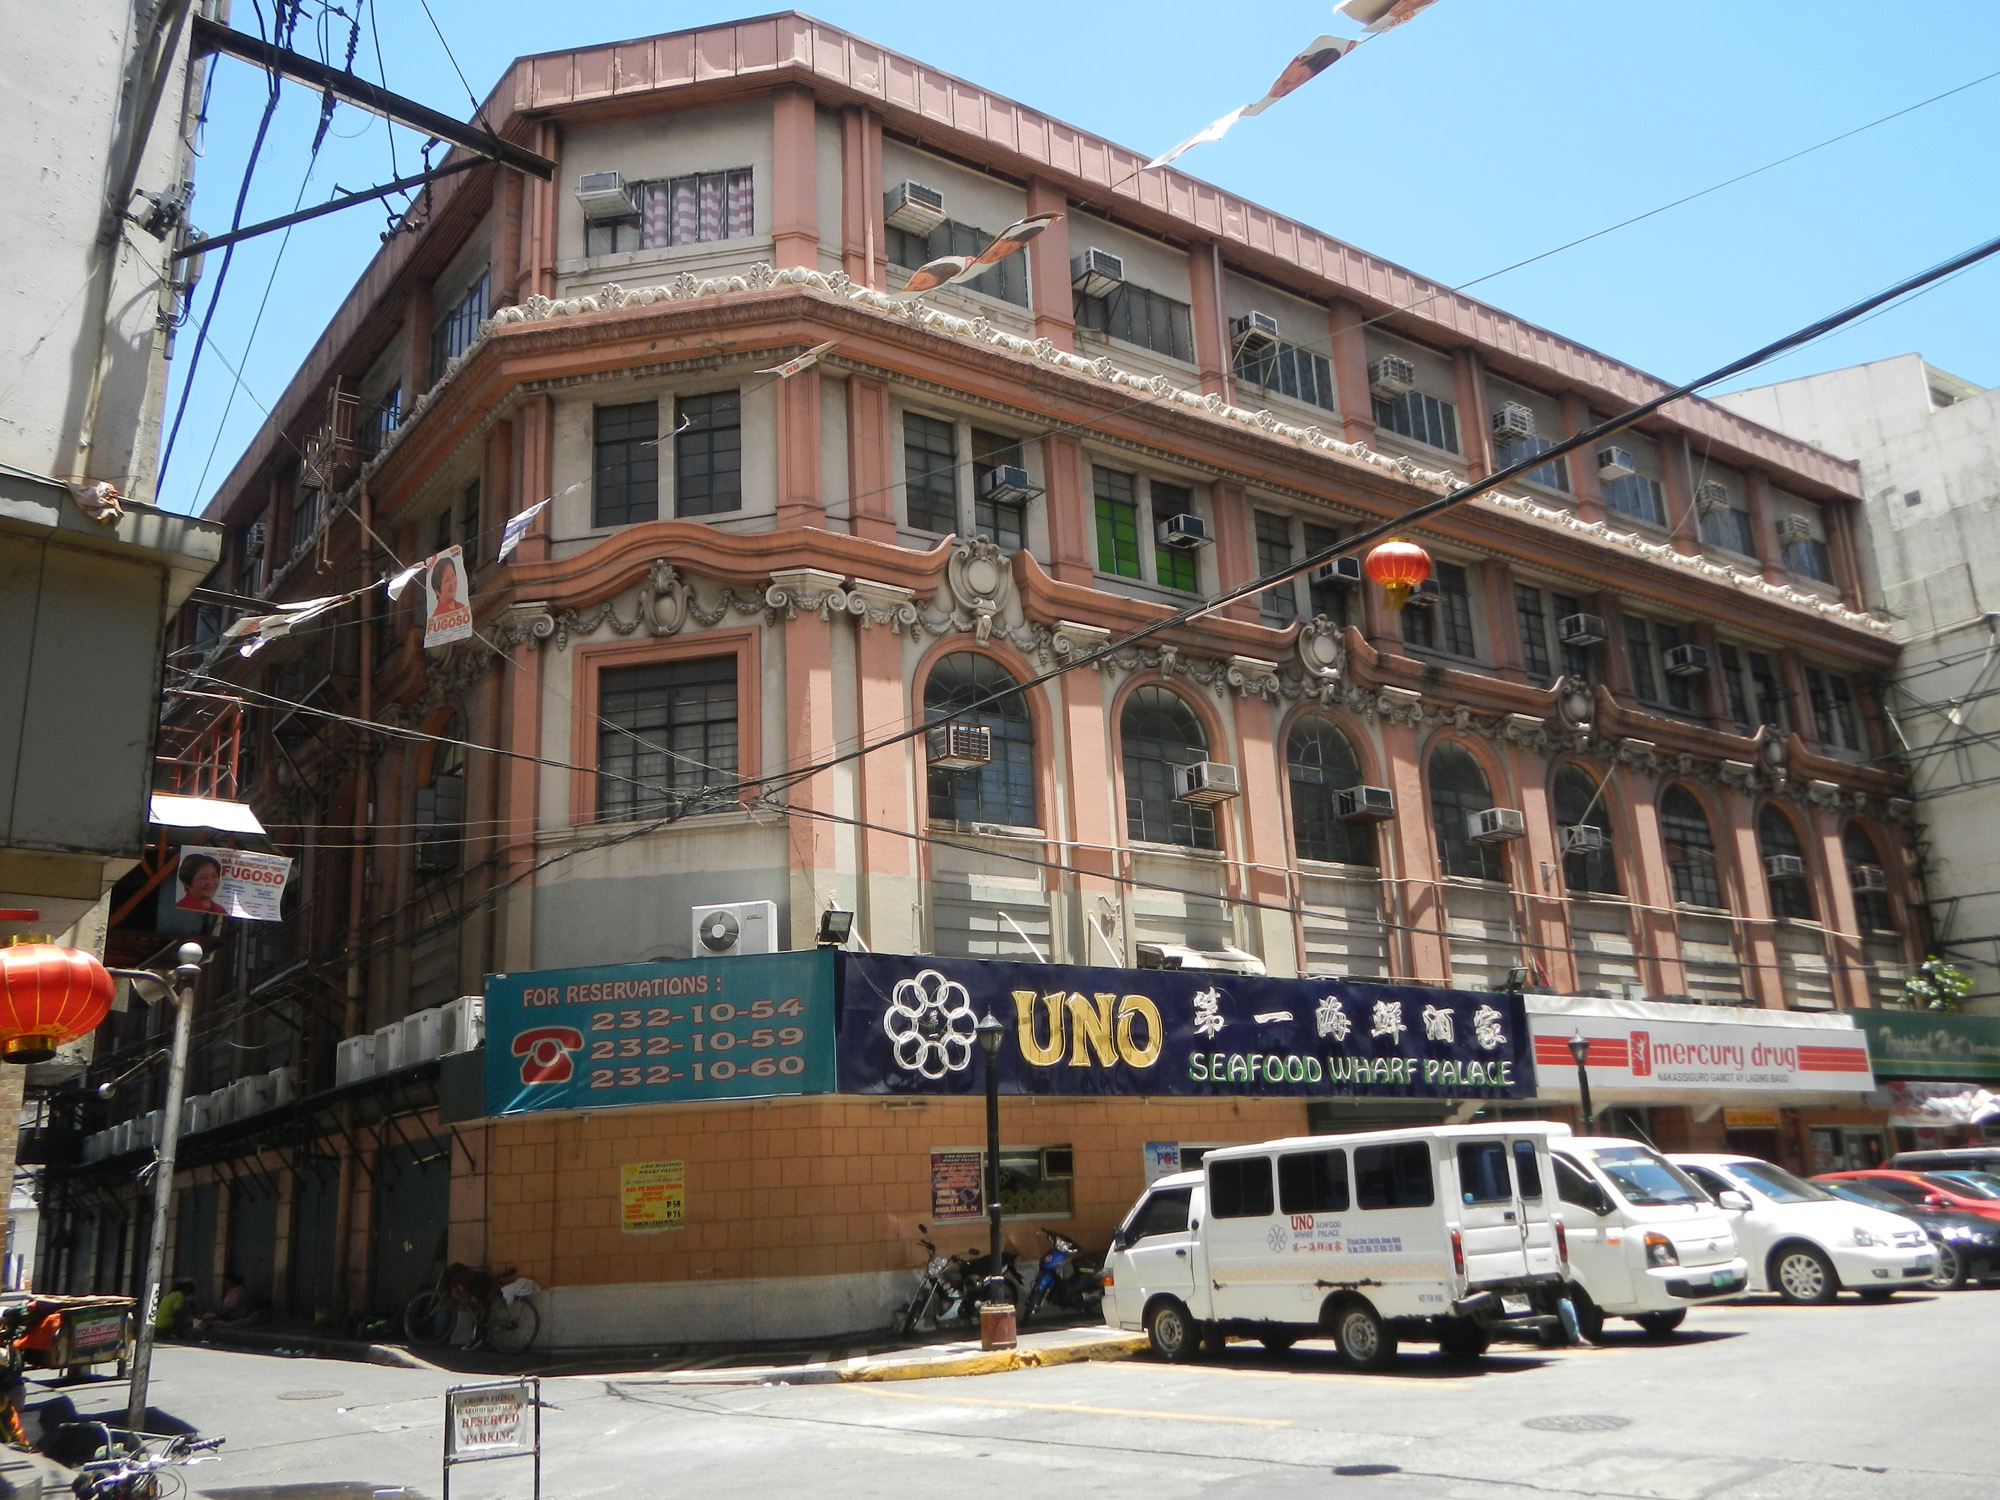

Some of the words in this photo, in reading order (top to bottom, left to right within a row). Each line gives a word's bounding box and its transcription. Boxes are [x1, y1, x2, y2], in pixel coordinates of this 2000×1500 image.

[427, 613, 471, 634] FUGOSO
[221, 865, 285, 886] FUGOSO
[234, 860, 268, 871] ASUNCION
[522, 987, 560, 1008] FOR
[566, 974, 709, 1004] RESERVATIONS
[590, 997, 806, 1032] 232-10-54
[1011, 989, 1164, 1069] UNO
[590, 1026, 805, 1061] 232-10-59
[1652, 1043, 1745, 1071] mercury
[1751, 1041, 1797, 1072] drug
[589, 1055, 806, 1090] 232-10-60
[1189, 1052, 1323, 1083] SEAFOOD
[1327, 1055, 1419, 1086] WHARF
[1422, 1057, 1516, 1087] PALACE
[1657, 1072, 1710, 1082] NAKASISIGURO
[1711, 1073, 1734, 1082] GAMOT
[1735, 1073, 1744, 1082] AY
[1745, 1073, 1769, 1083] LAGING
[1770, 1073, 1789, 1083] BAGO
[1157, 1152, 1178, 1165] POE
[1290, 1214, 1314, 1230] UNO
[1316, 1221, 1341, 1229] SEAFOOD
[1294, 1230, 1314, 1238] WHARF
[1318, 1229, 1340, 1237] PALACE
[75, 1323, 120, 1337] TOLENTINO
[461, 1413, 519, 1428] RESERVED
[466, 1430, 514, 1445] PARKING
